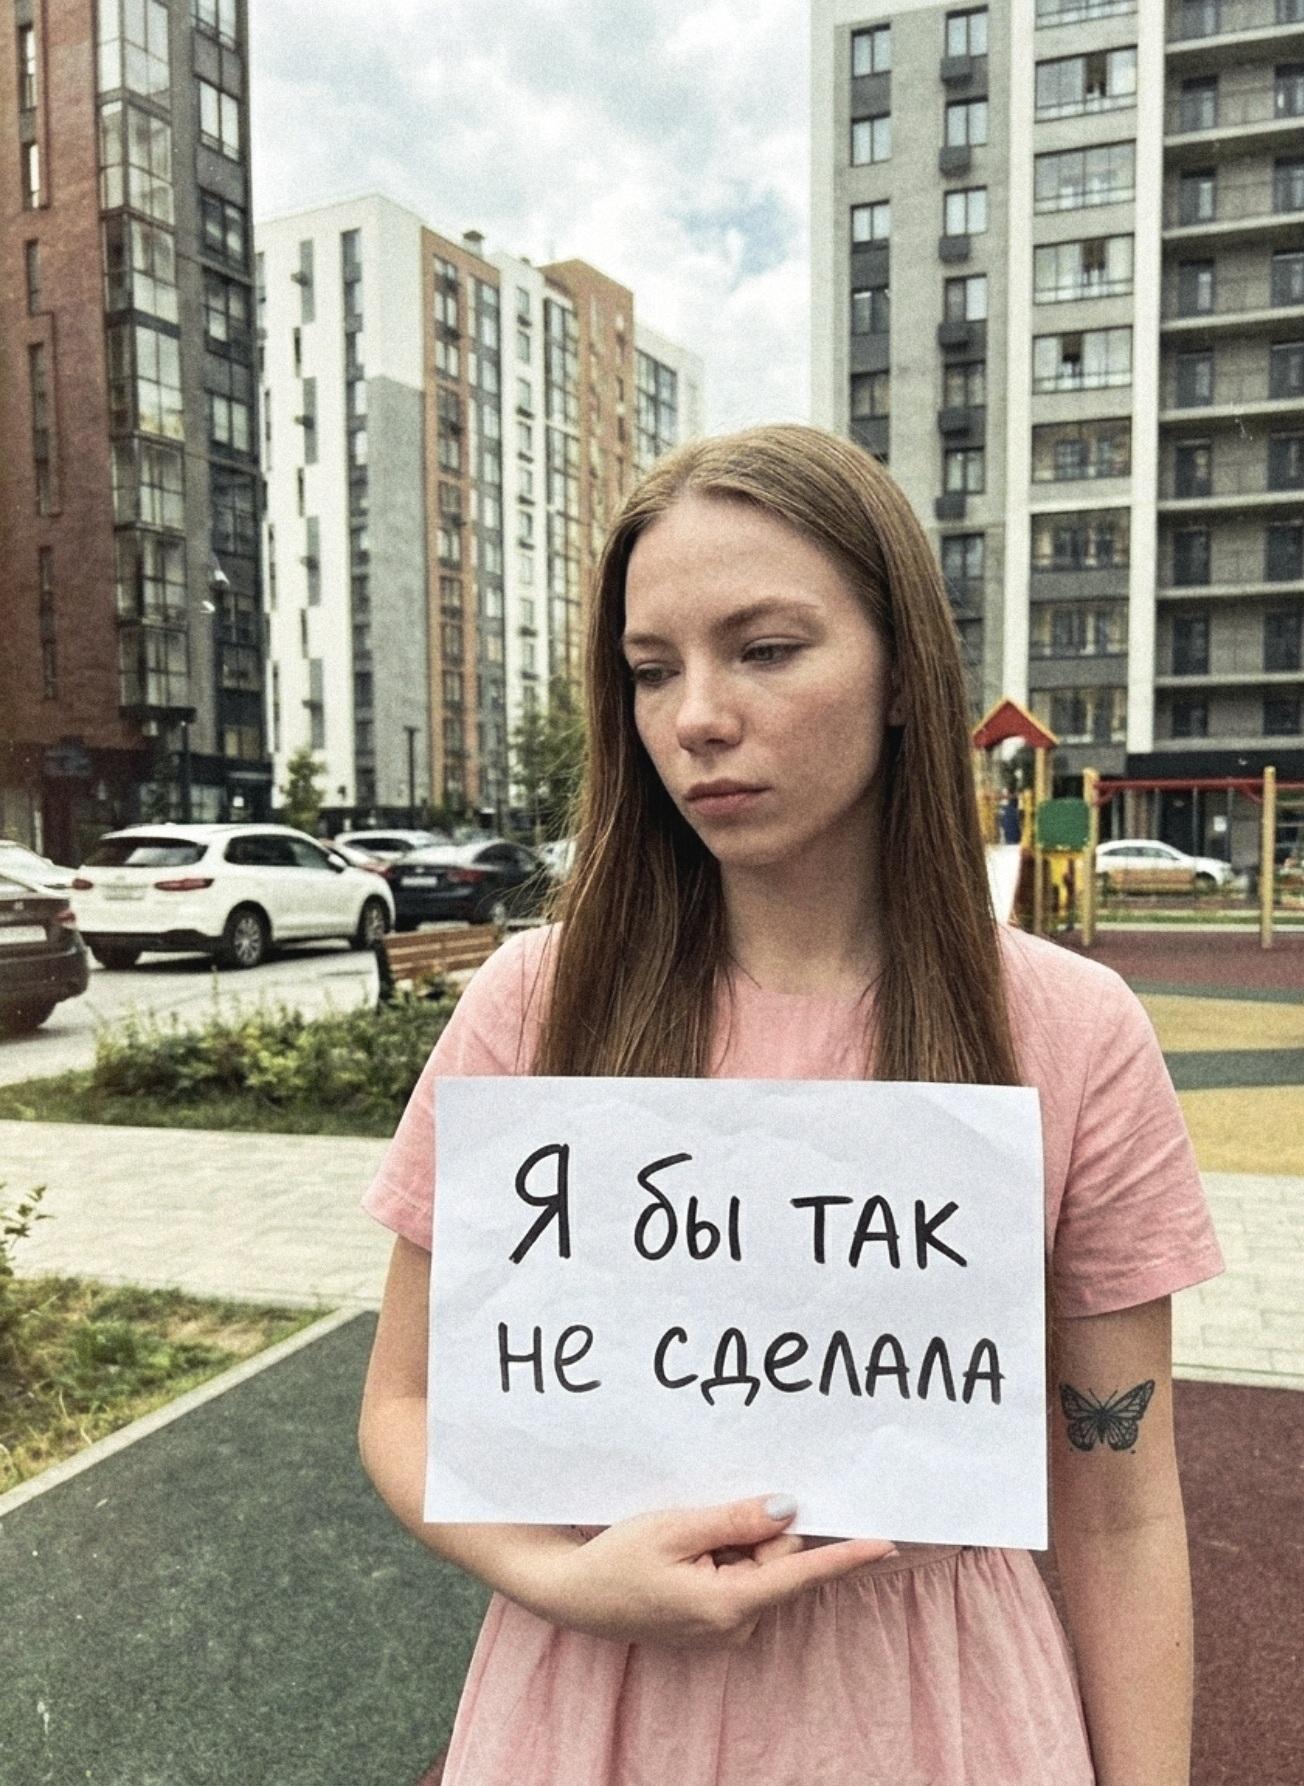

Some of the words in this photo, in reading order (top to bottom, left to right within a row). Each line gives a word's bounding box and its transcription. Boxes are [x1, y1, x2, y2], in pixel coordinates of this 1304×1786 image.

[509, 1142, 571, 1265] Я
[634, 1152, 742, 1262] бы
[498, 1321, 602, 1394] не
[654, 1325, 1006, 1407] сделала
